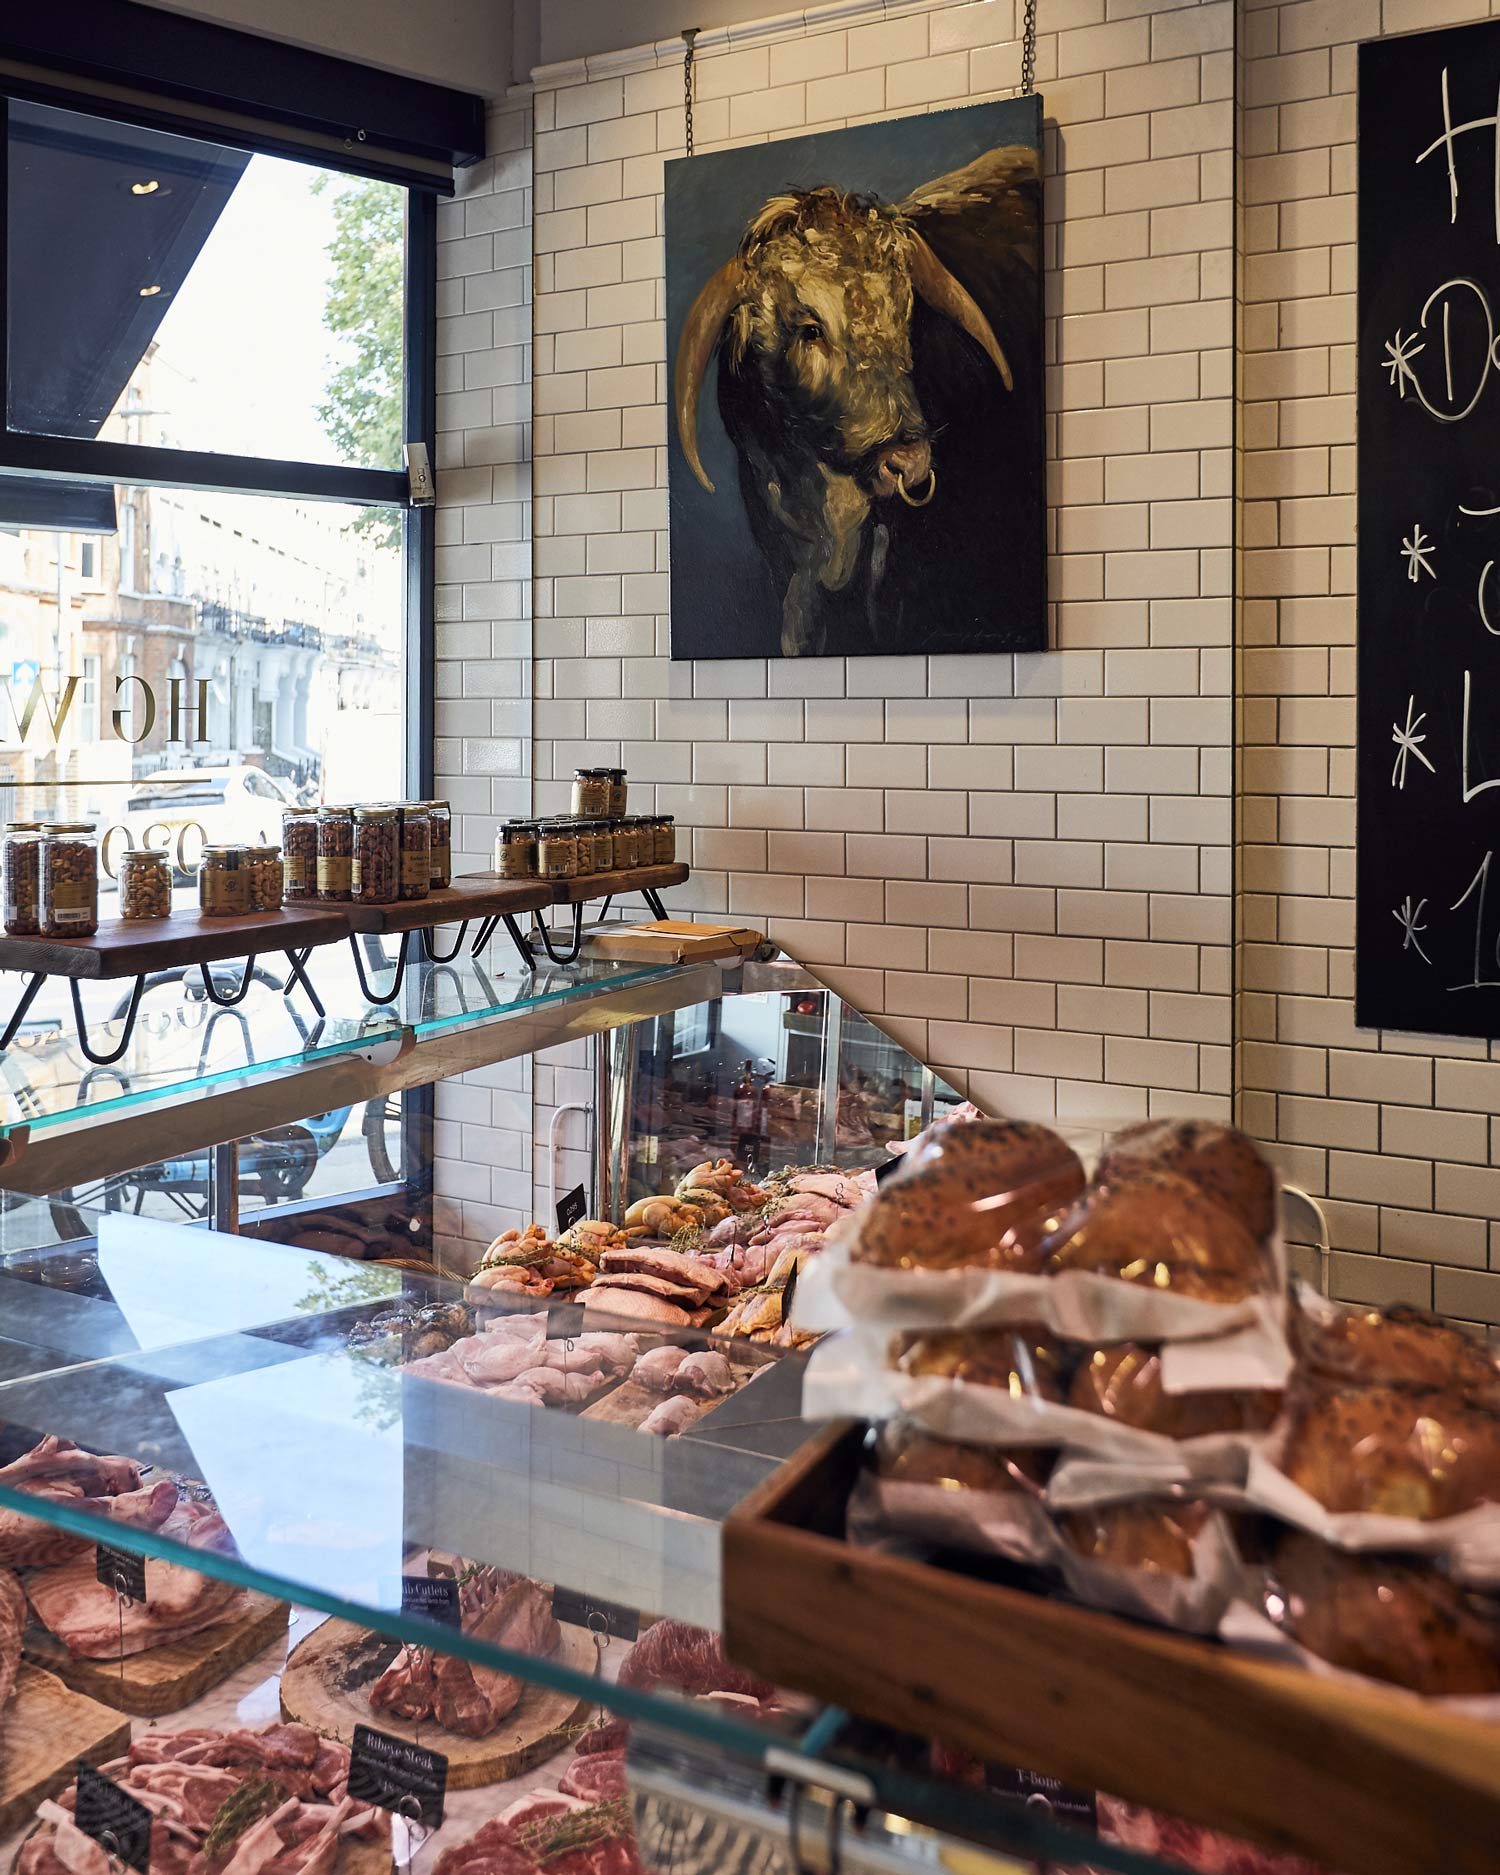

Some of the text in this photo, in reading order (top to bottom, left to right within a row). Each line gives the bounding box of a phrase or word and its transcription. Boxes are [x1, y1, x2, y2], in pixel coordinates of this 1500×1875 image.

[1446, 851, 1500, 992] 1
[415, 1583, 449, 1597] Cutlets
[367, 1732, 434, 1771] Ribeye Steak
[1016, 1768, 1062, 1791] T-Bone
